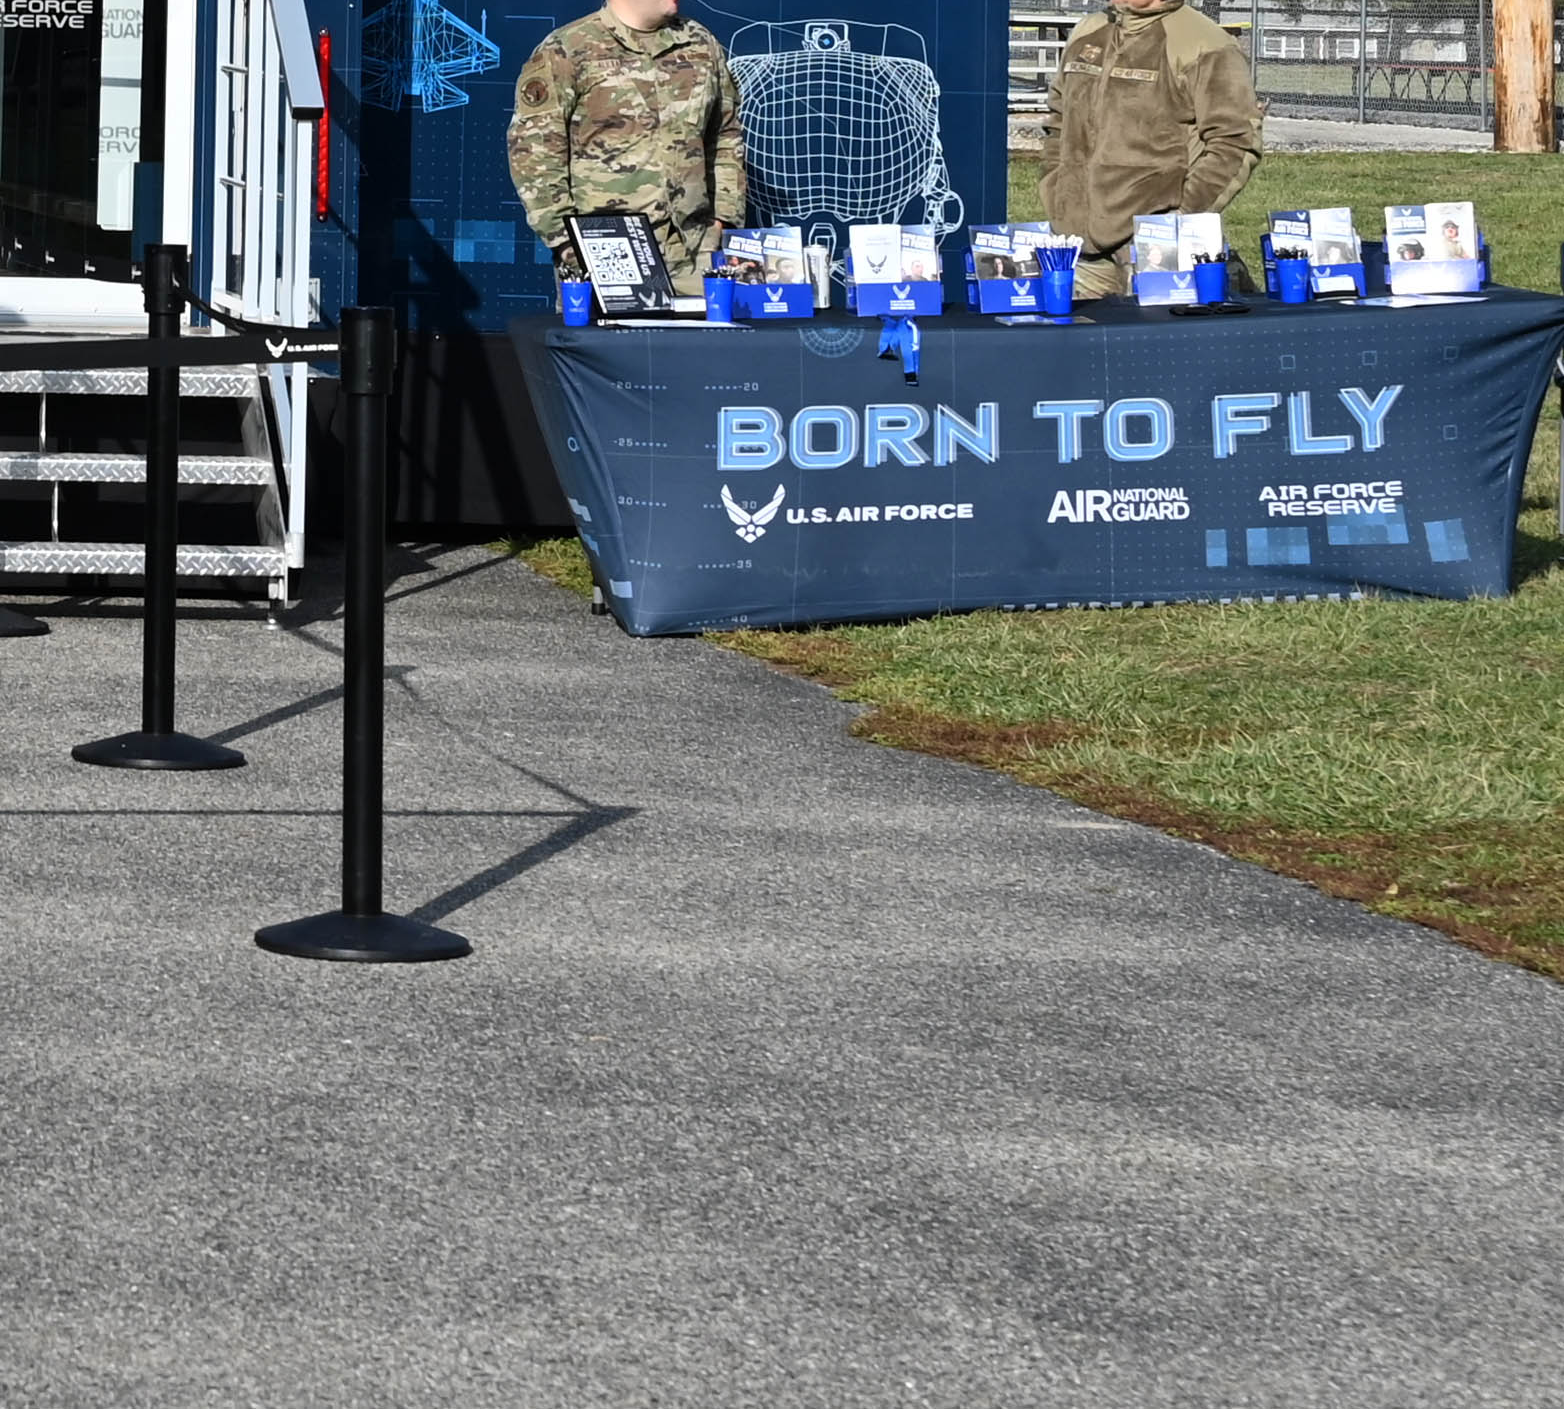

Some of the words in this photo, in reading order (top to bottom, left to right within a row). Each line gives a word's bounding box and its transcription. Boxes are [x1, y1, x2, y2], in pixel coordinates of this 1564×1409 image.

[11, 0, 94, 14] FORCE
[717, 402, 1000, 470] BORN
[1033, 397, 1175, 464] TO
[1211, 384, 1404, 459] FLY
[1258, 485, 1308, 502] AIR
[1313, 480, 1404, 499] FORCE
[786, 508, 832, 524] U.S.
[835, 506, 879, 522] AIR
[884, 503, 974, 521] FORCE
[1047, 489, 1113, 524] AIR
[1113, 487, 1188, 504] NATIONAL
[1112, 501, 1190, 522] GUARD
[1268, 497, 1397, 517] RESERVE
